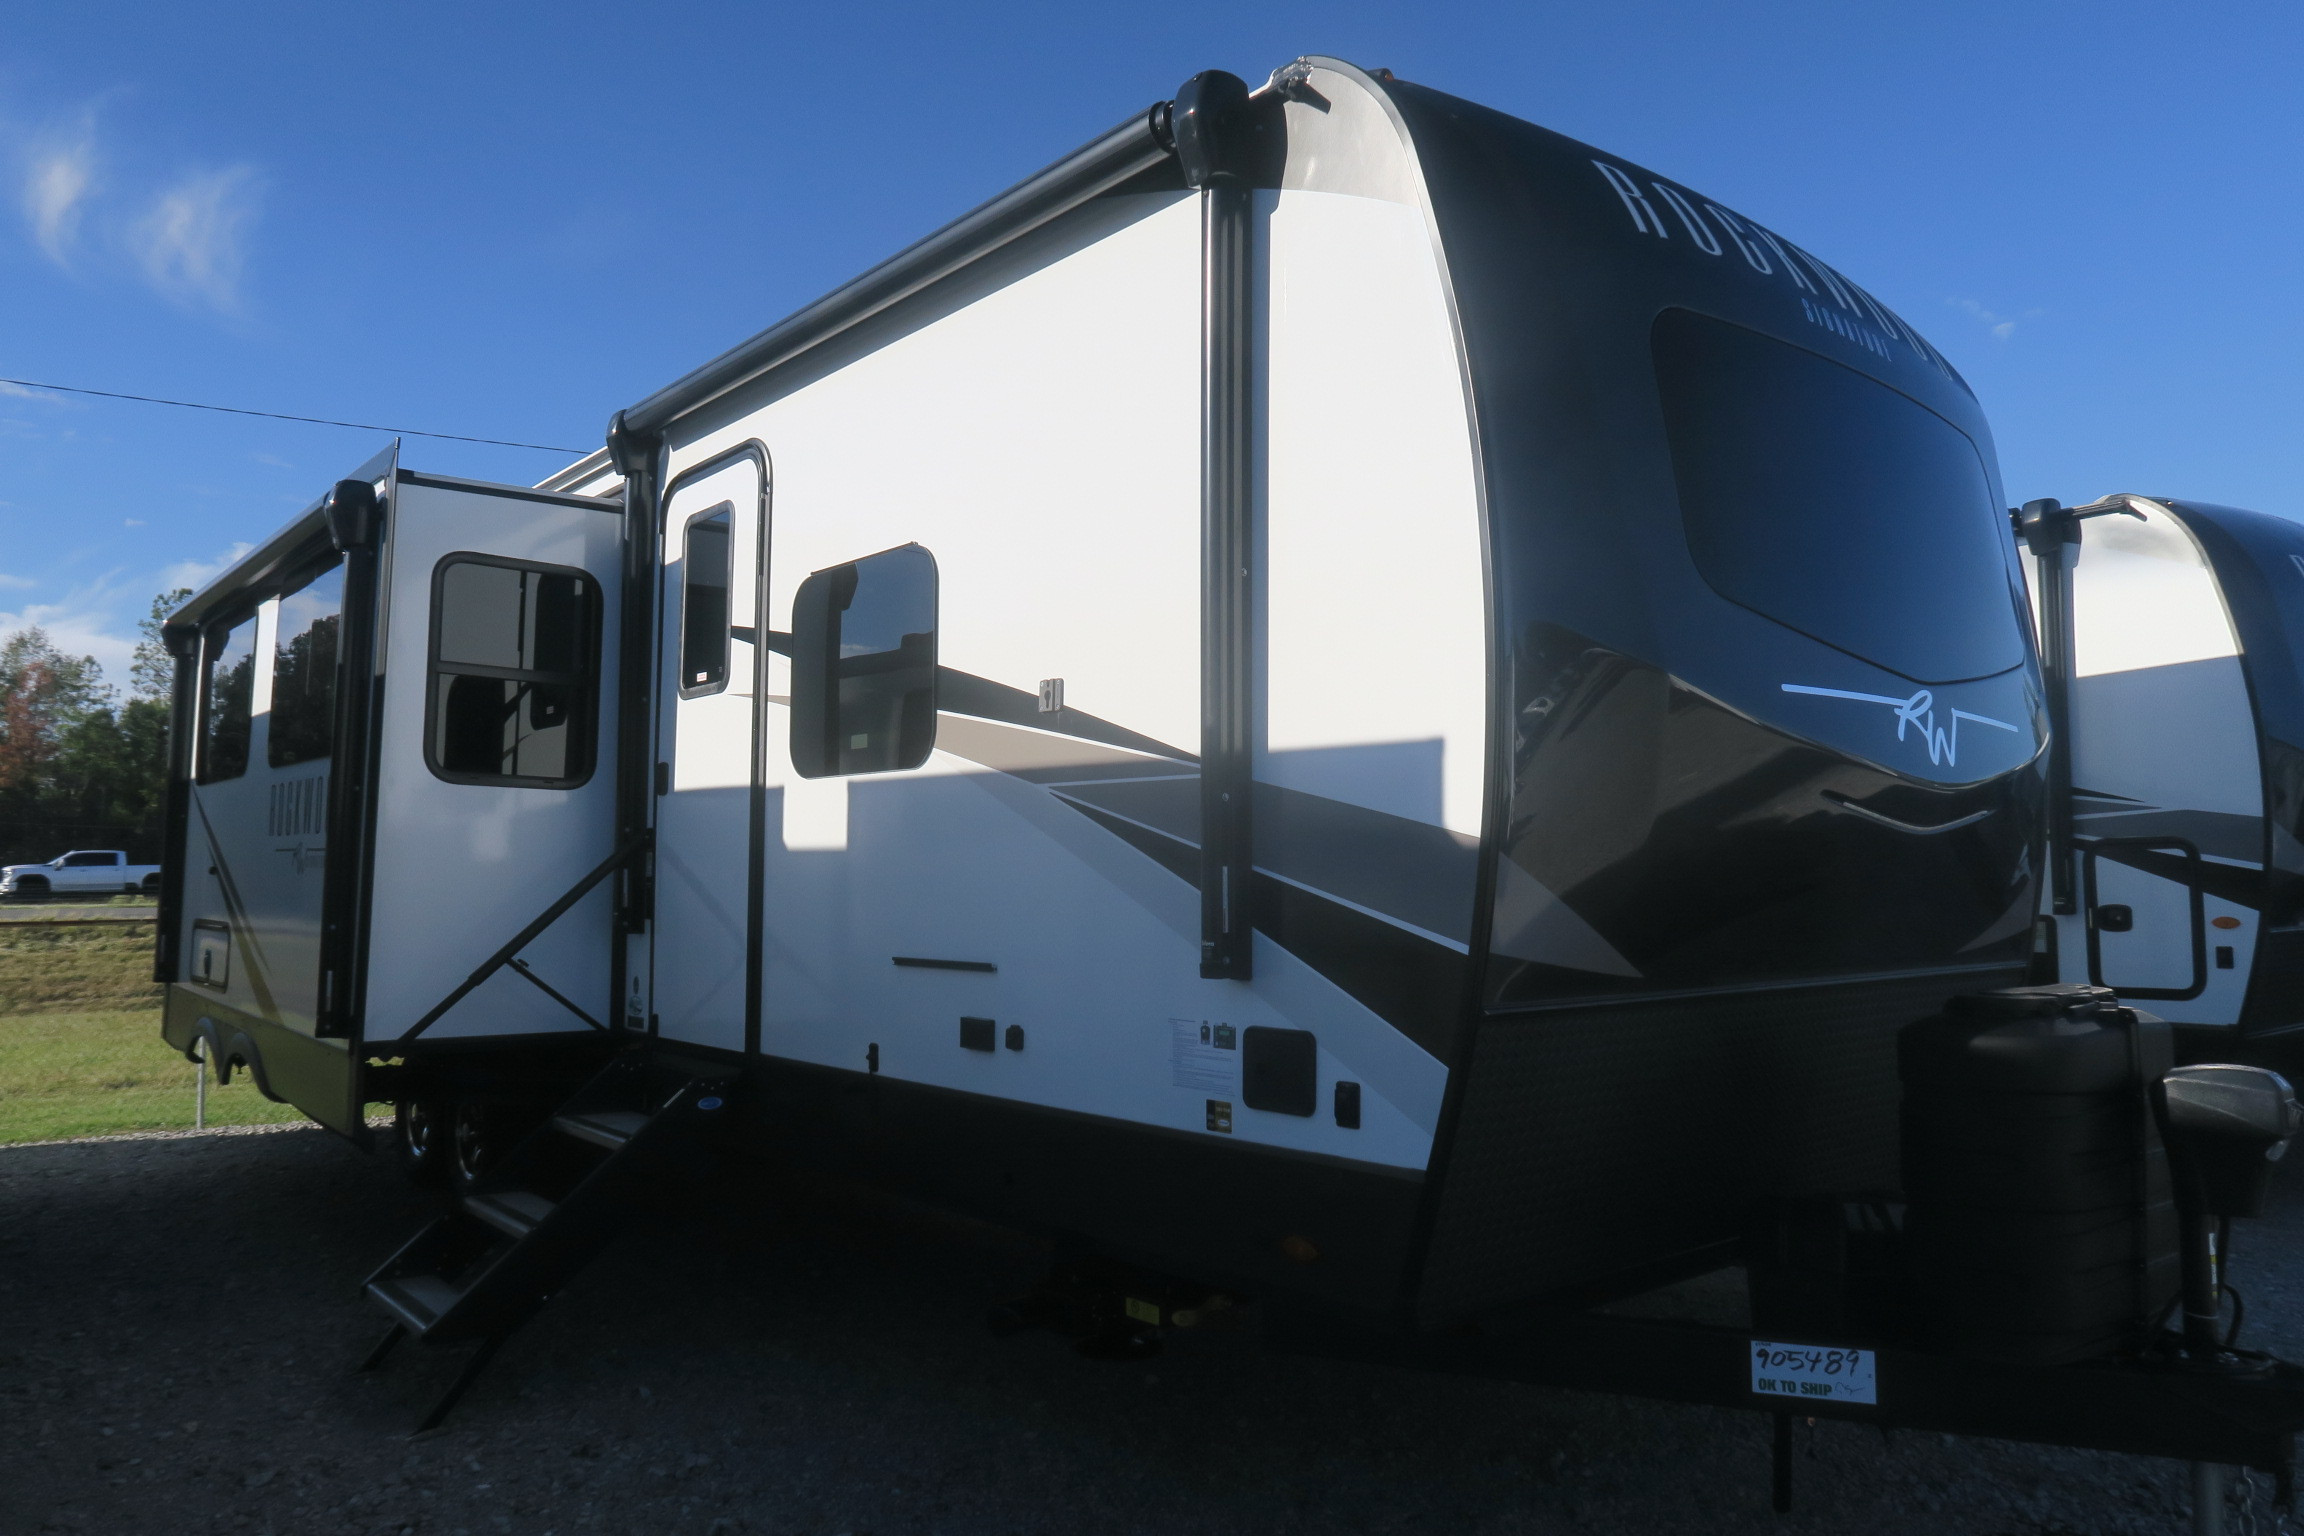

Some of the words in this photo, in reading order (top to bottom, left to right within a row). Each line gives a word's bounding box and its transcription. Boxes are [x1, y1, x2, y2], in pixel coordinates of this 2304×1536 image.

[1756, 1348, 1860, 1378] 905489
[1758, 1378, 1776, 1392] OK
[1780, 1379, 1797, 1393] TO
[1800, 1382, 1833, 1396] SHIP
